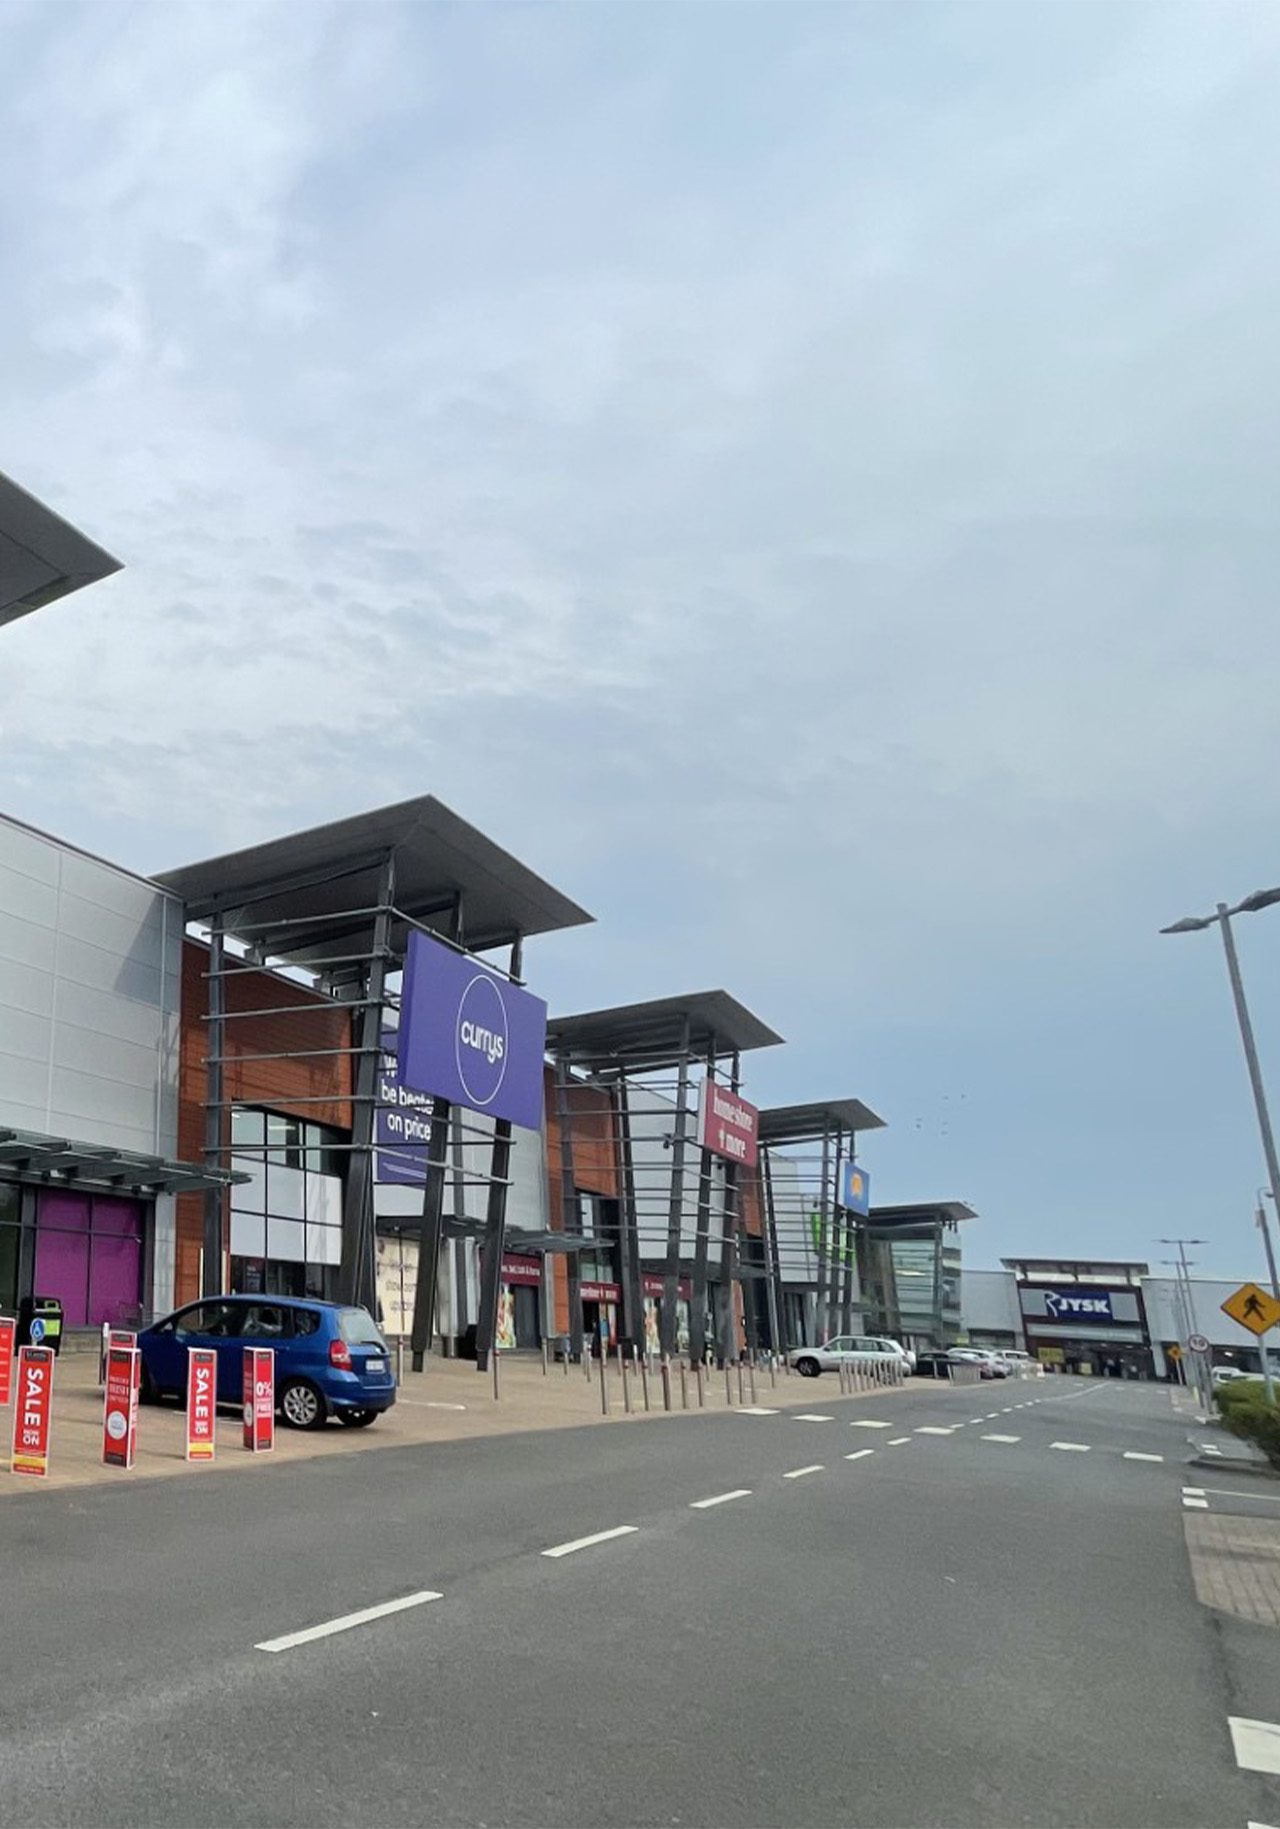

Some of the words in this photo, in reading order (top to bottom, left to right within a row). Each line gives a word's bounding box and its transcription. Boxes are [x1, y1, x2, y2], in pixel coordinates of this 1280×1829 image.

[461, 1021, 503, 1064] currys
[381, 1079, 397, 1103] be
[387, 1114, 403, 1132] on
[404, 1116, 432, 1141] price
[1058, 1298, 1110, 1313] JYSK
[24, 1367, 43, 1426] SALE
[196, 1368, 209, 1418] SALE
[256, 1381, 272, 1396] 0%
